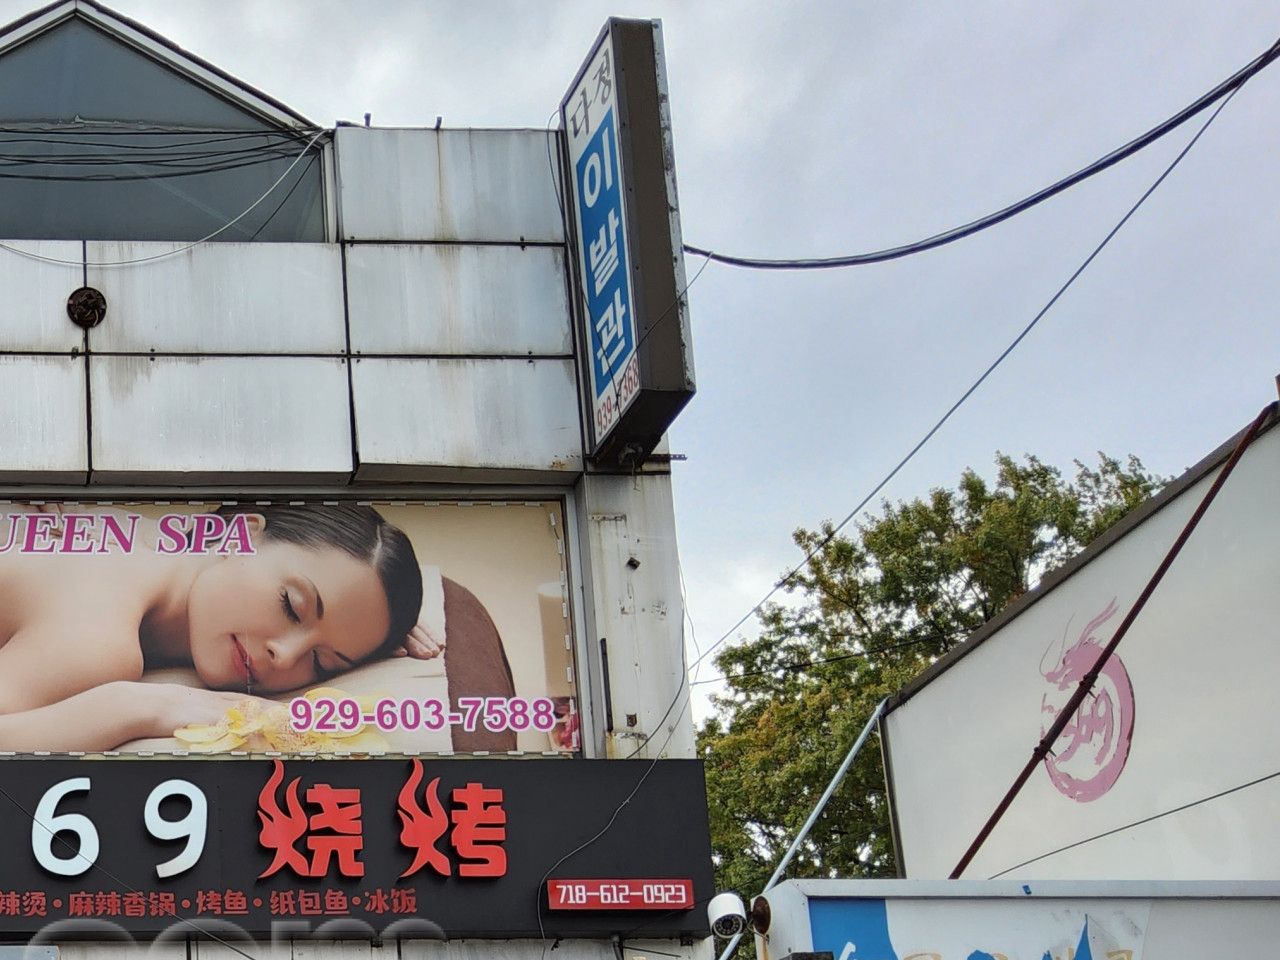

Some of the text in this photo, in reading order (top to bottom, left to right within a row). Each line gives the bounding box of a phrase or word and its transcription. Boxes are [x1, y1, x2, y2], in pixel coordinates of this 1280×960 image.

[155, 513, 258, 556] SPA
[290, 696, 558, 735] 929-603-7588
[558, 883, 686, 907] 718-612-0923
